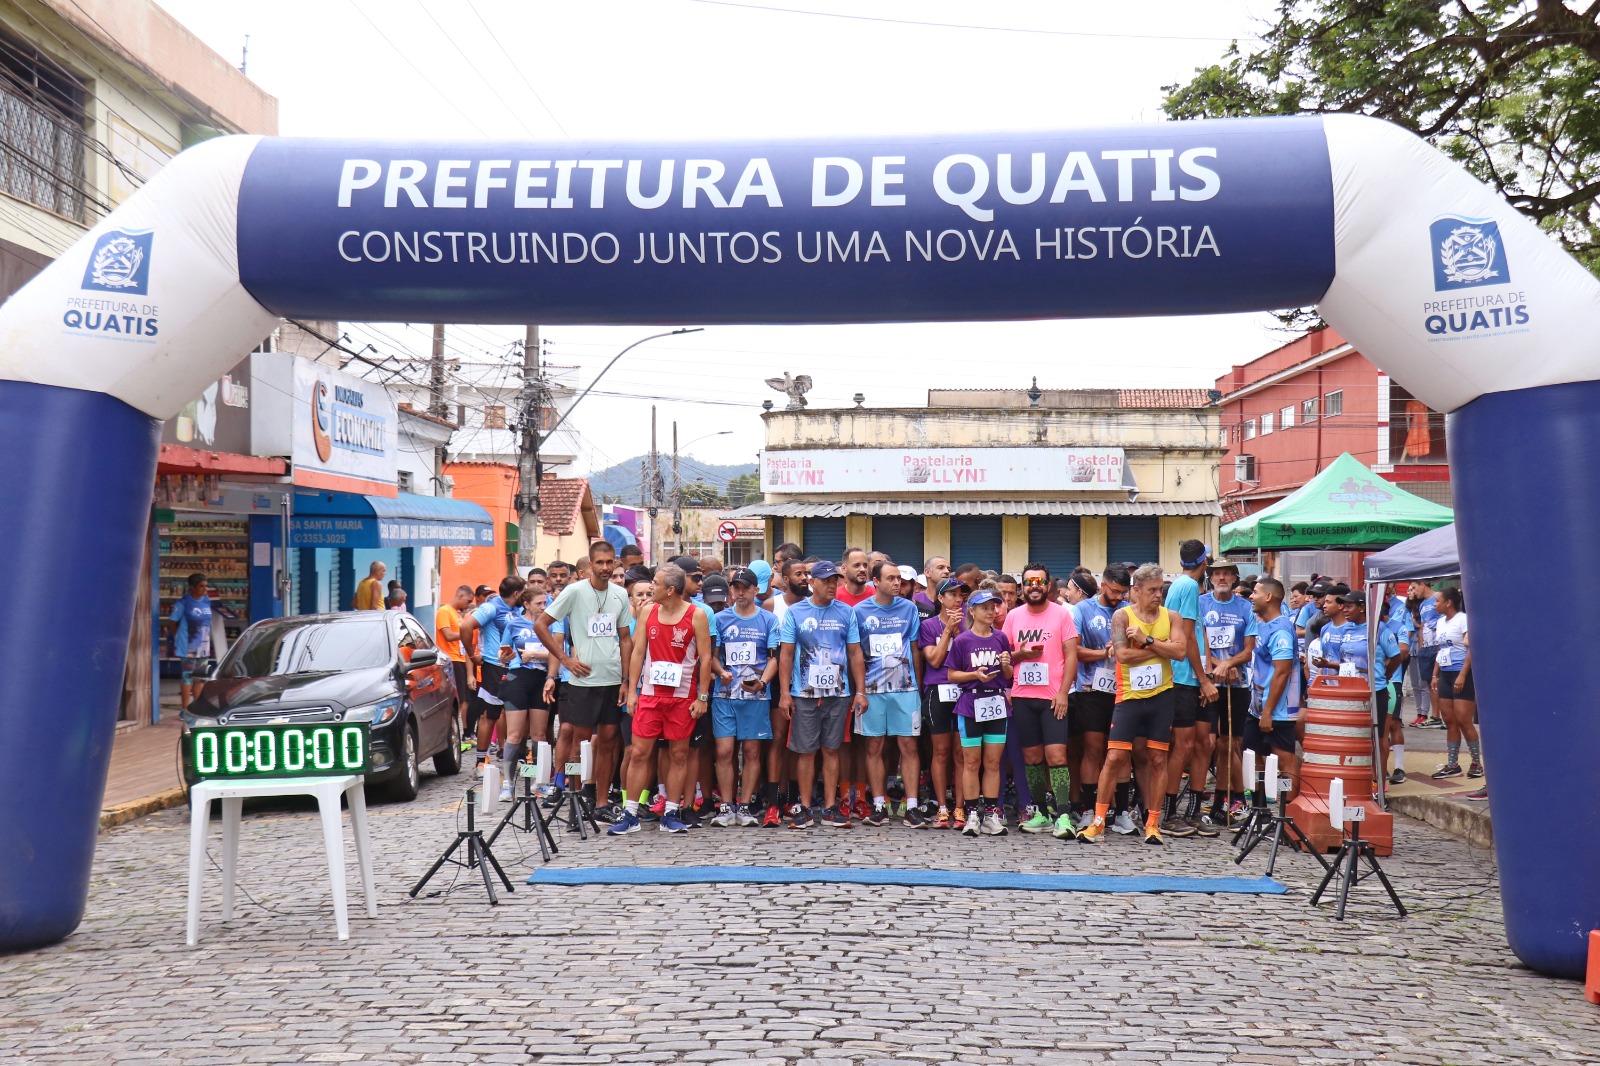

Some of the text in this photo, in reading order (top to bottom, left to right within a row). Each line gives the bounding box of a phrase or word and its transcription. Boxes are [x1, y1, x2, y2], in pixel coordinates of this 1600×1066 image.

[337, 147, 1221, 222] PREFEITURA DE QUATIS
[338, 217, 1221, 264] CONSTRUINDO JUNTOS UMA NOVA HISTÓRIA
[67, 297, 159, 317] PREFEITURA DE
[1423, 291, 1526, 313] PREFEITURA DE
[63, 309, 159, 337] QUATIS
[1424, 304, 1530, 335] QUATIS
[766, 457, 812, 469] Pastelaria
[903, 454, 972, 466] Pastelaria
[780, 470, 824, 485] LLYNI
[932, 468, 987, 483] LLYNI
[304, 520, 332, 530] SANTA
[335, 521, 363, 530] MARIA
[1302, 526, 1330, 535] EQUIPE
[1332, 526, 1358, 534] SENNA
[1365, 525, 1390, 534] VOLTA
[302, 534, 346, 544] 3353-3025
[592, 622, 612, 633] 004
[1210, 635, 1230, 645] 282
[875, 642, 897, 652] 064
[731, 650, 750, 662] 063
[654, 670, 676, 682] 244
[815, 674, 834, 685] 168
[1023, 672, 1042, 682] 183
[1137, 674, 1157, 687] 221
[981, 705, 1002, 718] 236
[196, 727, 364, 773] 00:00:00
